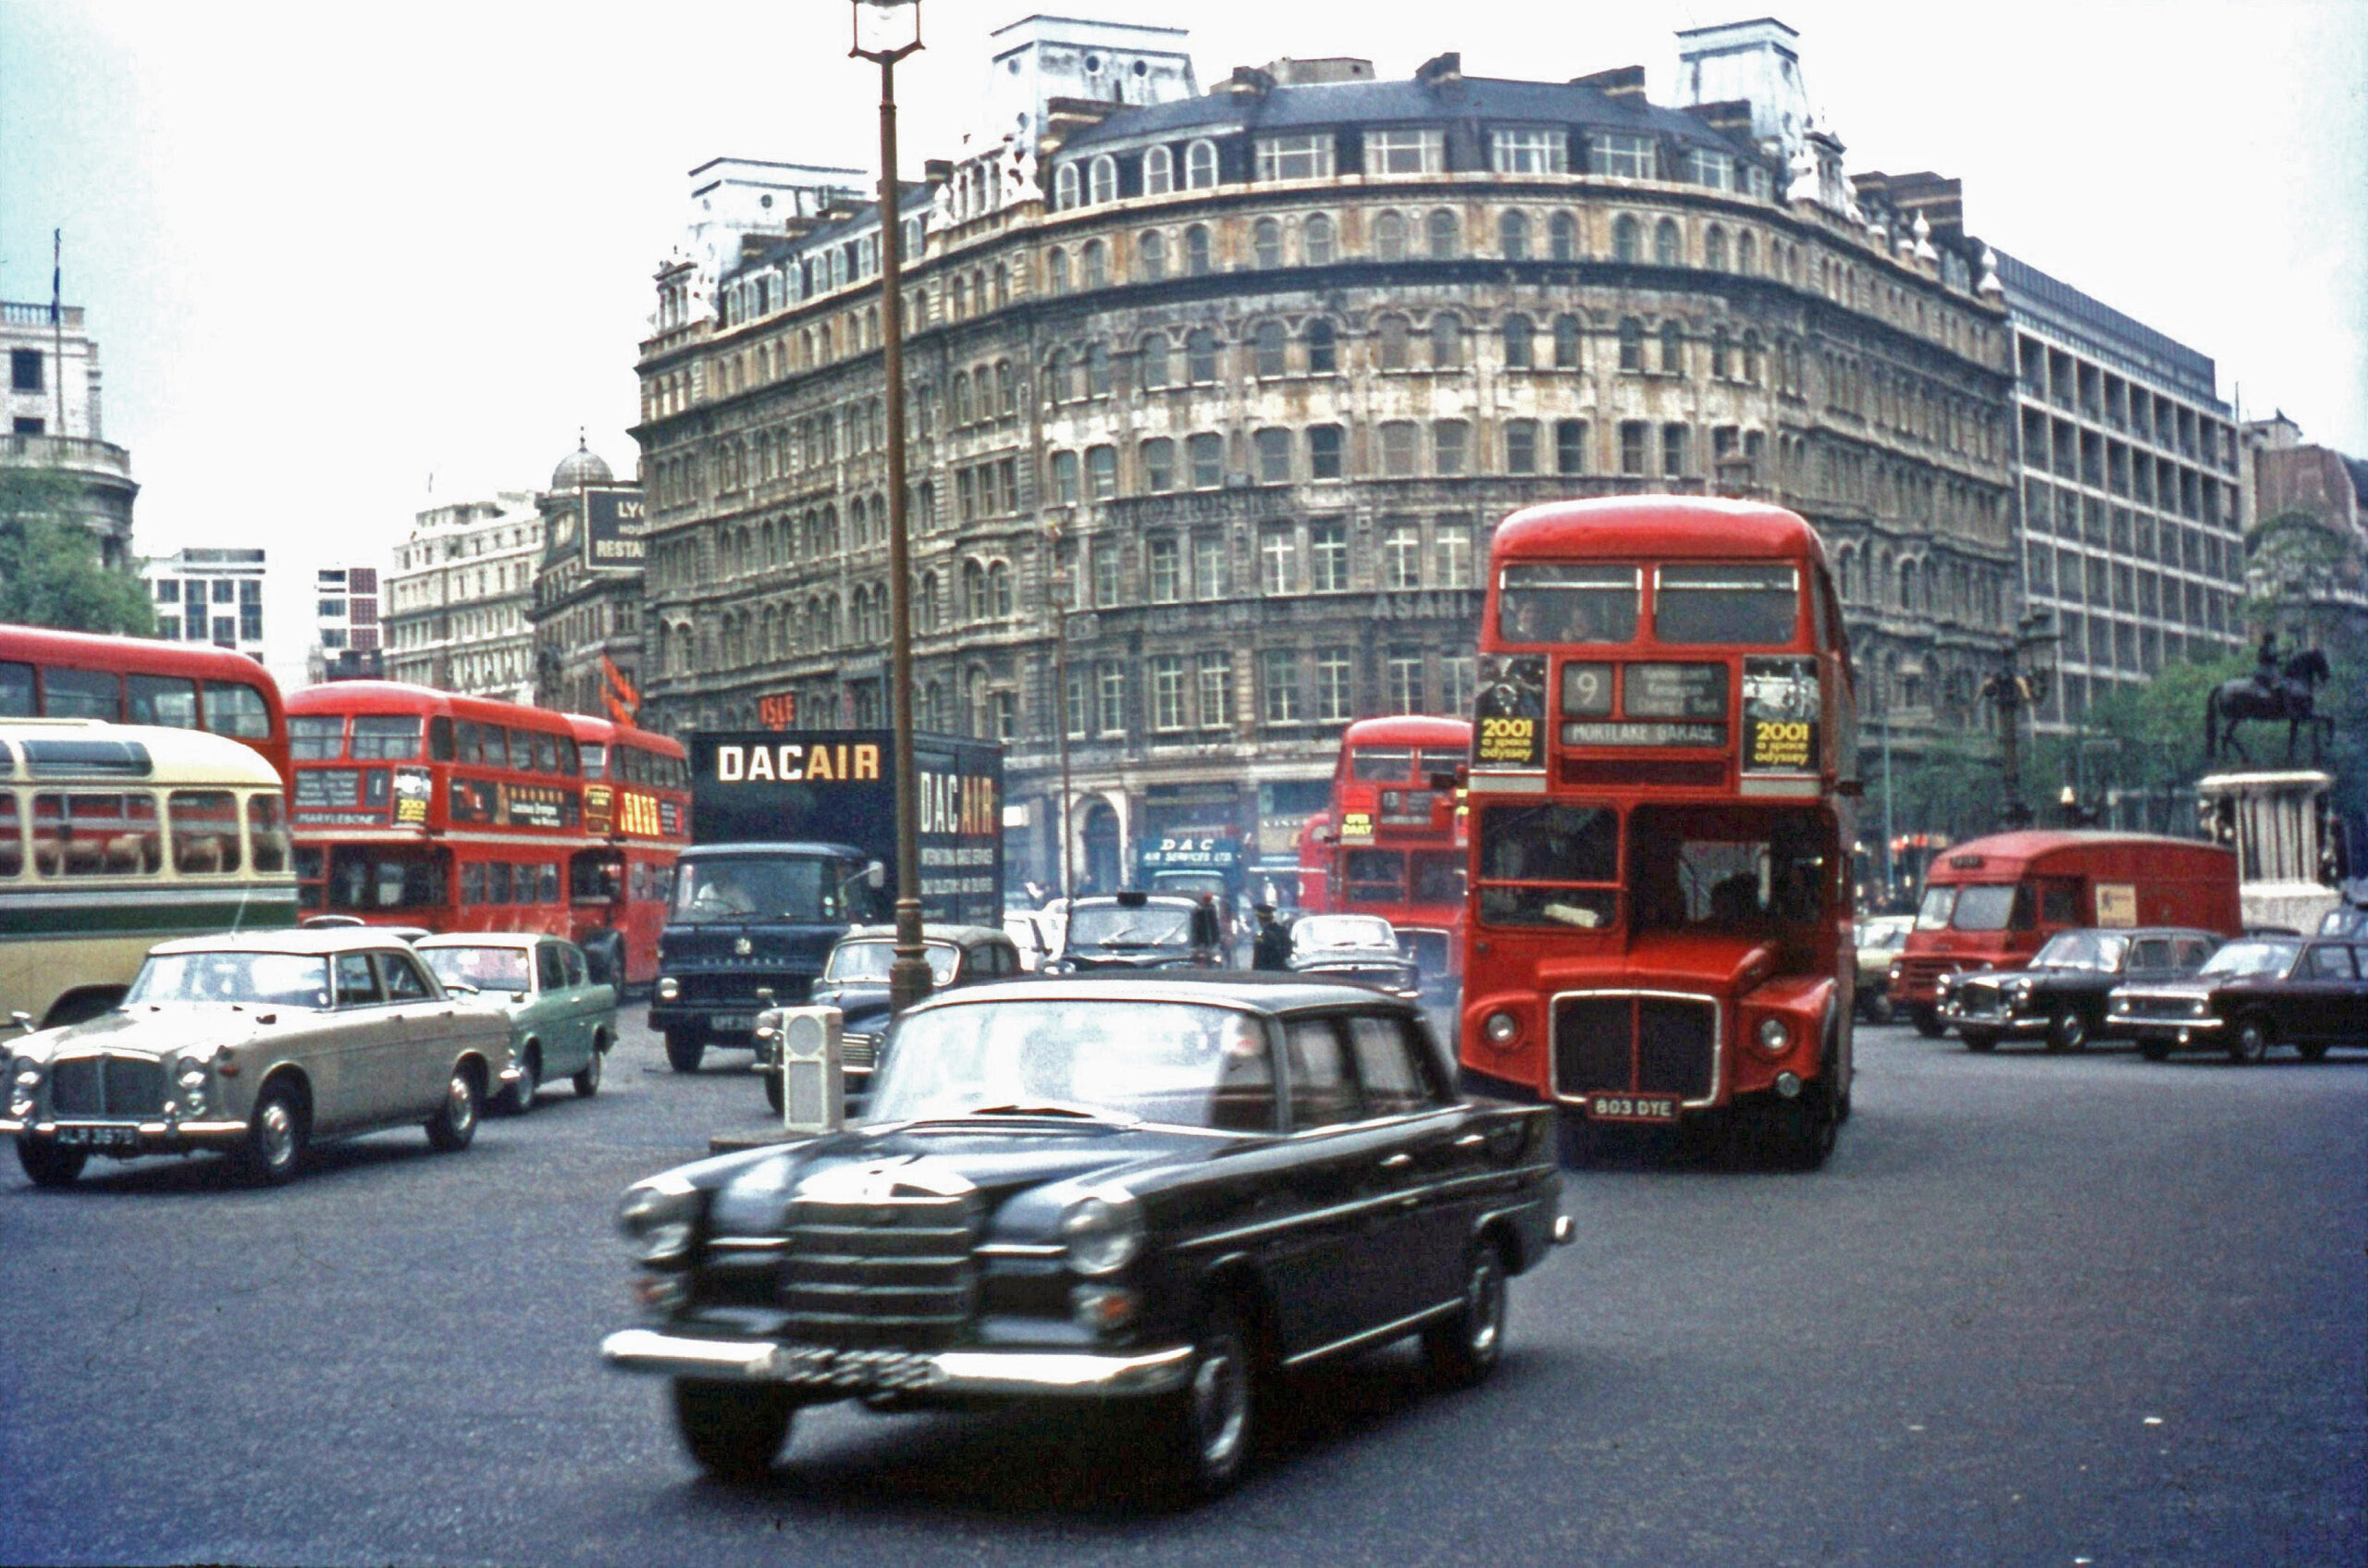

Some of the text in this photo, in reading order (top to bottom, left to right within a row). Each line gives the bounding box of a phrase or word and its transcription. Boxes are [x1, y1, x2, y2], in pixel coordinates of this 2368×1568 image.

[1372, 592, 1470, 620] ASAHI
[1577, 672, 1598, 705] 9
[760, 695, 795, 724] ISLE
[1483, 719, 1534, 737] 2001
[1573, 723, 1717, 742] MORTLAKE GARAGE
[1757, 722, 1809, 741] 2001
[718, 744, 880, 782] DACAIR
[1480, 747, 1532, 761] odyssey
[1755, 753, 1808, 766] odyssey
[297, 813, 376, 824] MARYLEBONE
[1143, 852, 1162, 862] AIR
[1165, 852, 1212, 863] SERVICES
[1596, 1098, 1671, 1116] 803 DYE
